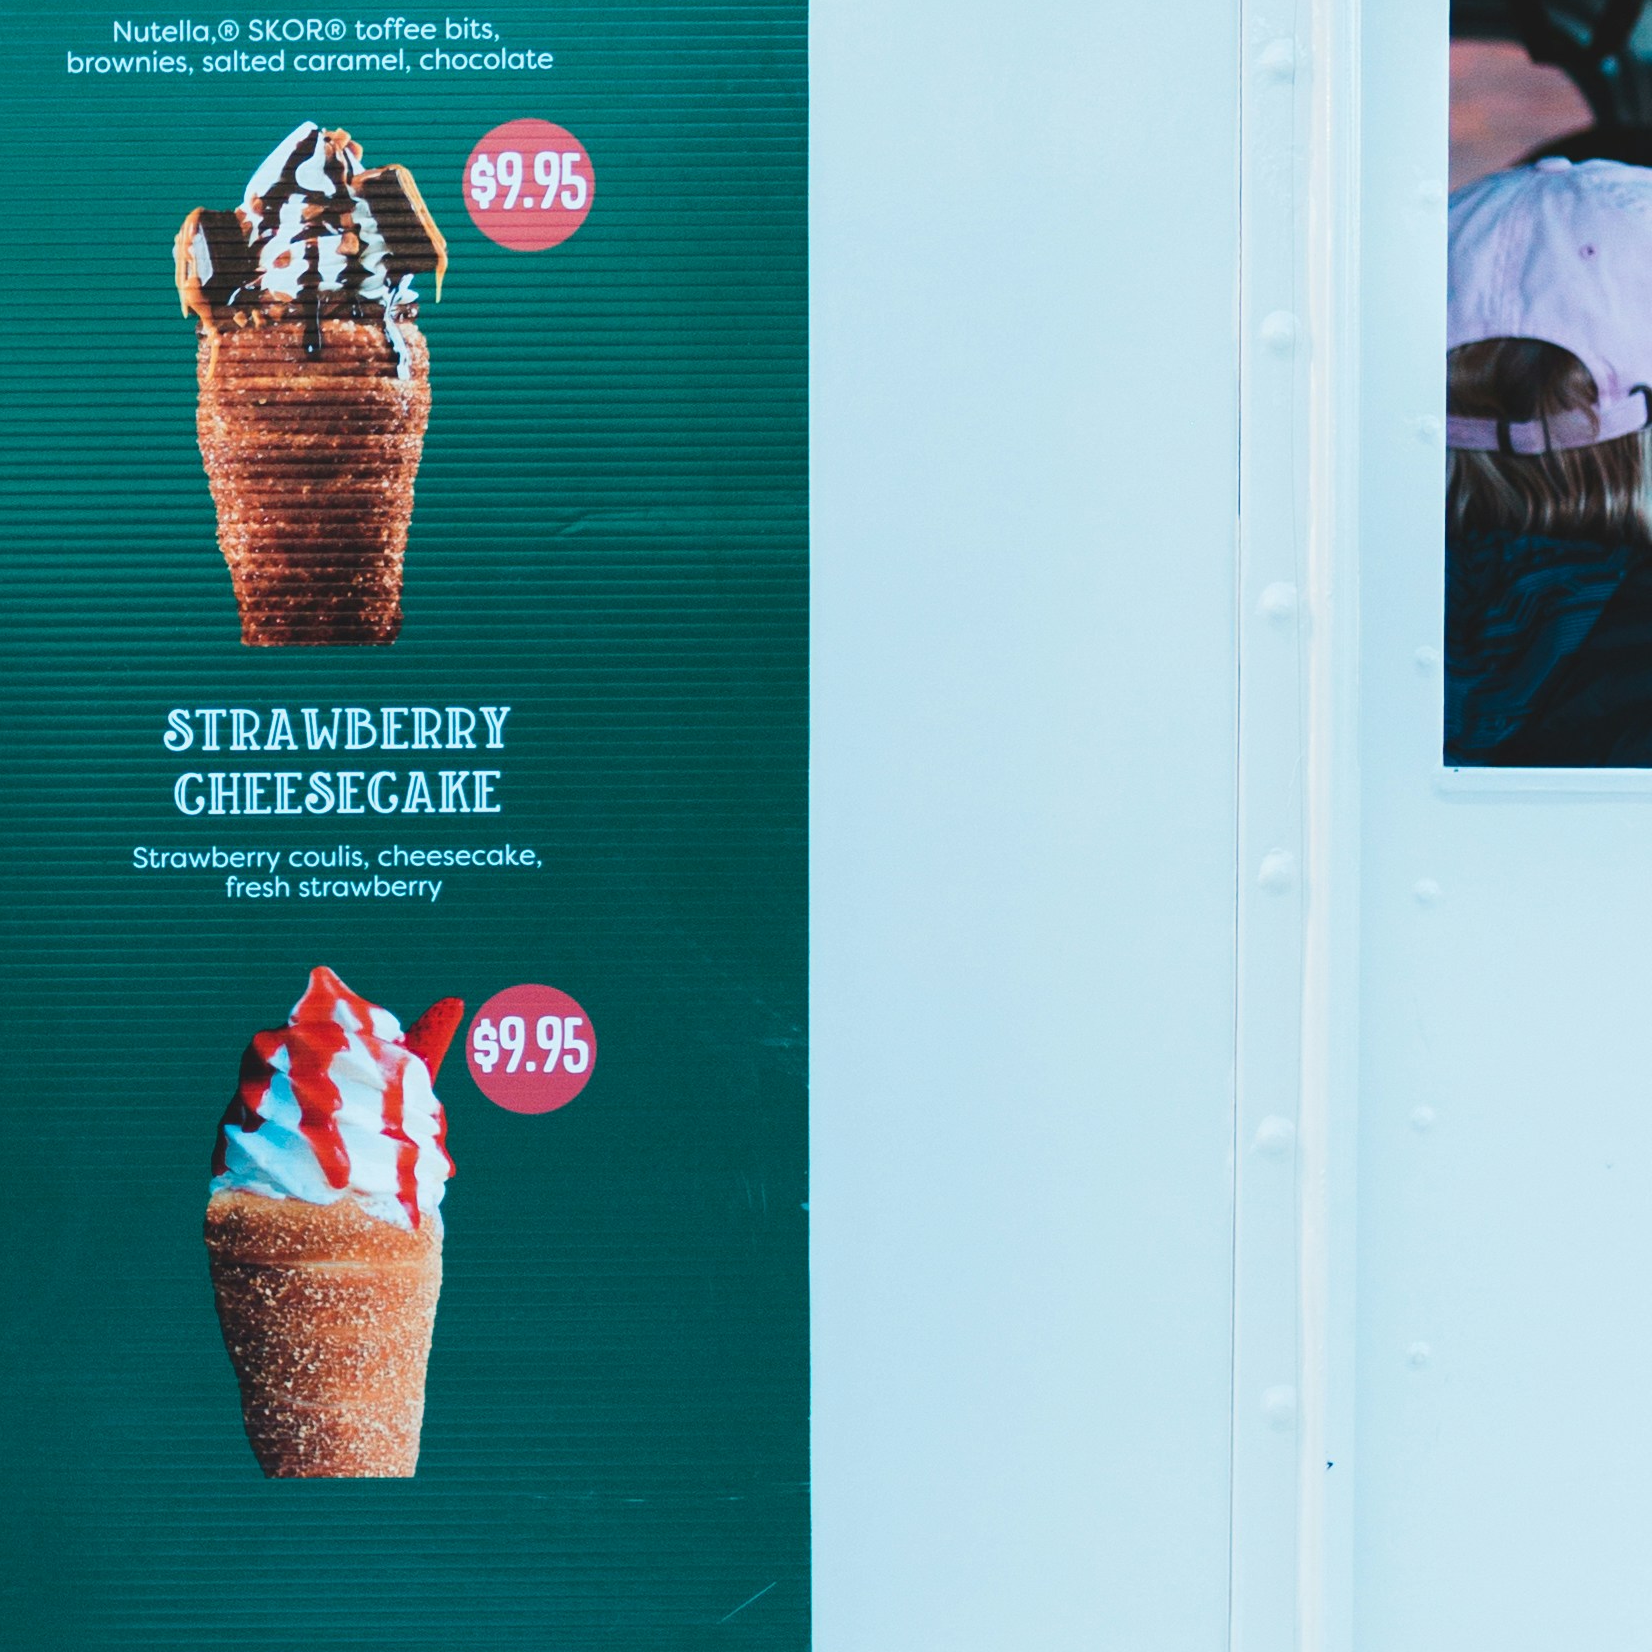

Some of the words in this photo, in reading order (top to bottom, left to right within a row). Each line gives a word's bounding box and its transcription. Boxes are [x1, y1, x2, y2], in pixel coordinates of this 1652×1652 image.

[355, 18, 437, 40] toffee
[445, 18, 500, 42] bits,
[67, 50, 193, 76] brownies,
[202, 49, 285, 73] salted
[294, 49, 411, 74] caramel,
[419, 47, 554, 71] chocolate
[471, 152, 586, 209] $9.95
[163, 707, 511, 752] STRAWBERRY
[173, 771, 502, 816] CHEESECAKE
[132, 846, 280, 874] Strawberry
[288, 844, 370, 870] coulis,
[377, 844, 544, 870] cheesecake,
[226, 876, 290, 898] fresh
[298, 875, 442, 903] strawberry
[474, 1016, 588, 1073] $9.95
